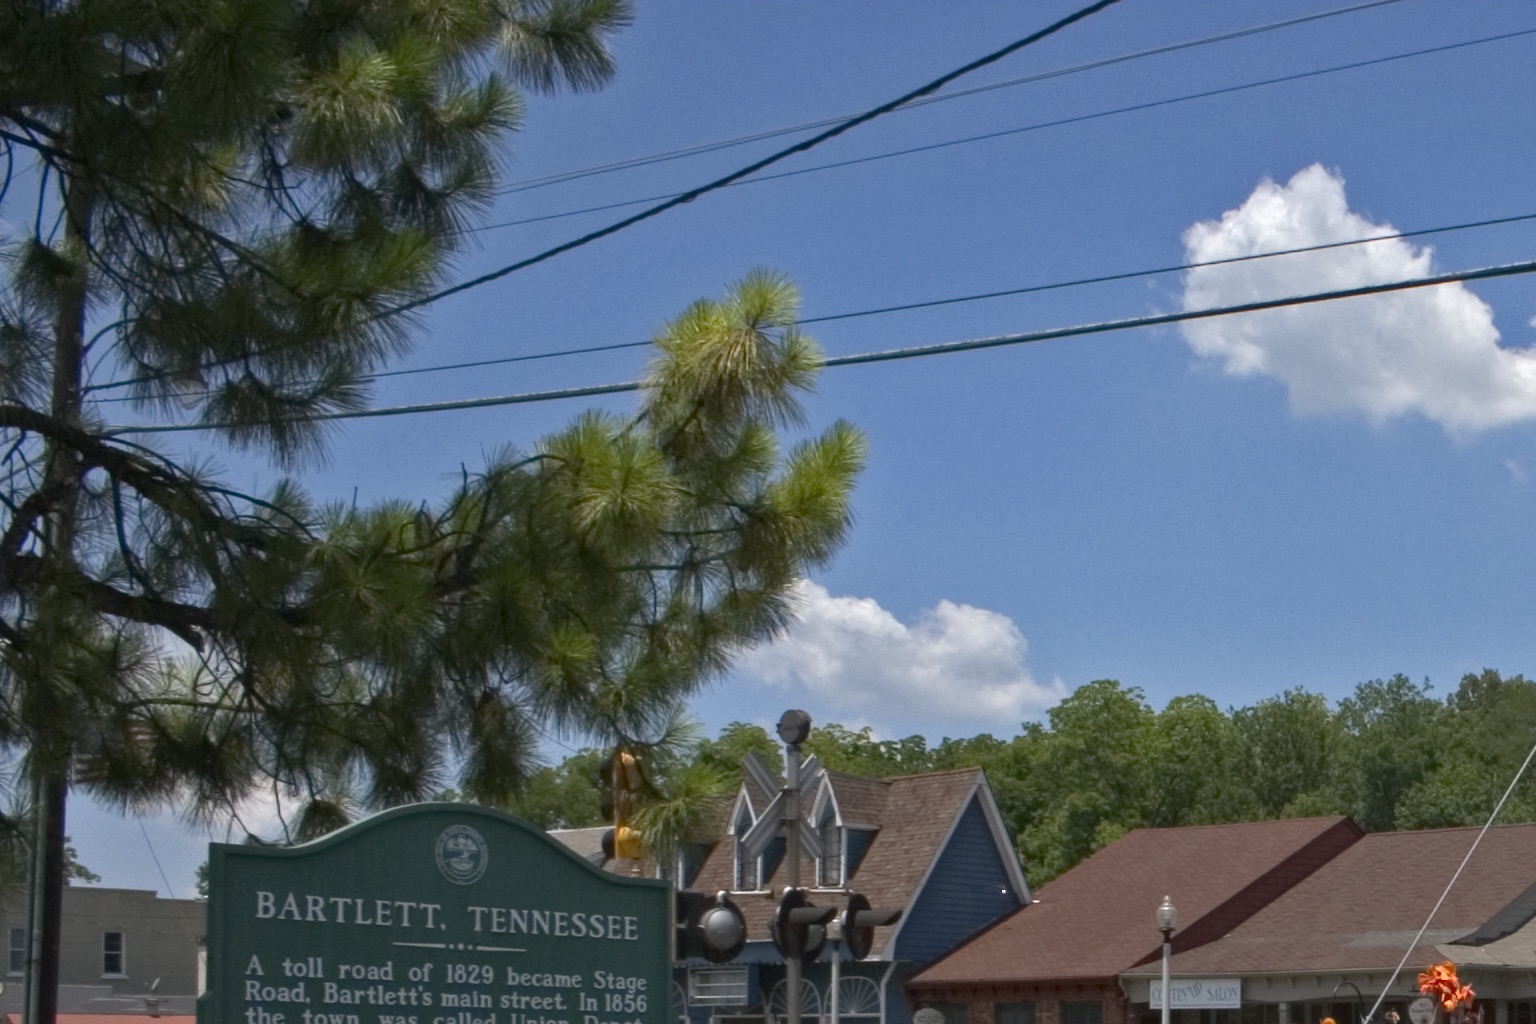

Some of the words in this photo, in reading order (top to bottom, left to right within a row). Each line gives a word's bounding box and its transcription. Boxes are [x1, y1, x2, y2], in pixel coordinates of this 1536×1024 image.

[468, 906, 638, 940] TENNESSEE
[245, 955, 264, 975] A
[282, 958, 324, 978] toll
[339, 961, 393, 980] road
[409, 963, 433, 982] of
[447, 964, 494, 984] 1829
[507, 967, 582, 988] became
[594, 971, 646, 992] Stage
[245, 980, 310, 1004] Road,
[324, 982, 432, 1006] Bartlett's
[441, 991, 492, 1008] main
[500, 992, 567, 1010] street.
[580, 992, 598, 1011] In
[605, 993, 646, 1012] 1856
[1207, 986, 1239, 1001] SALON
